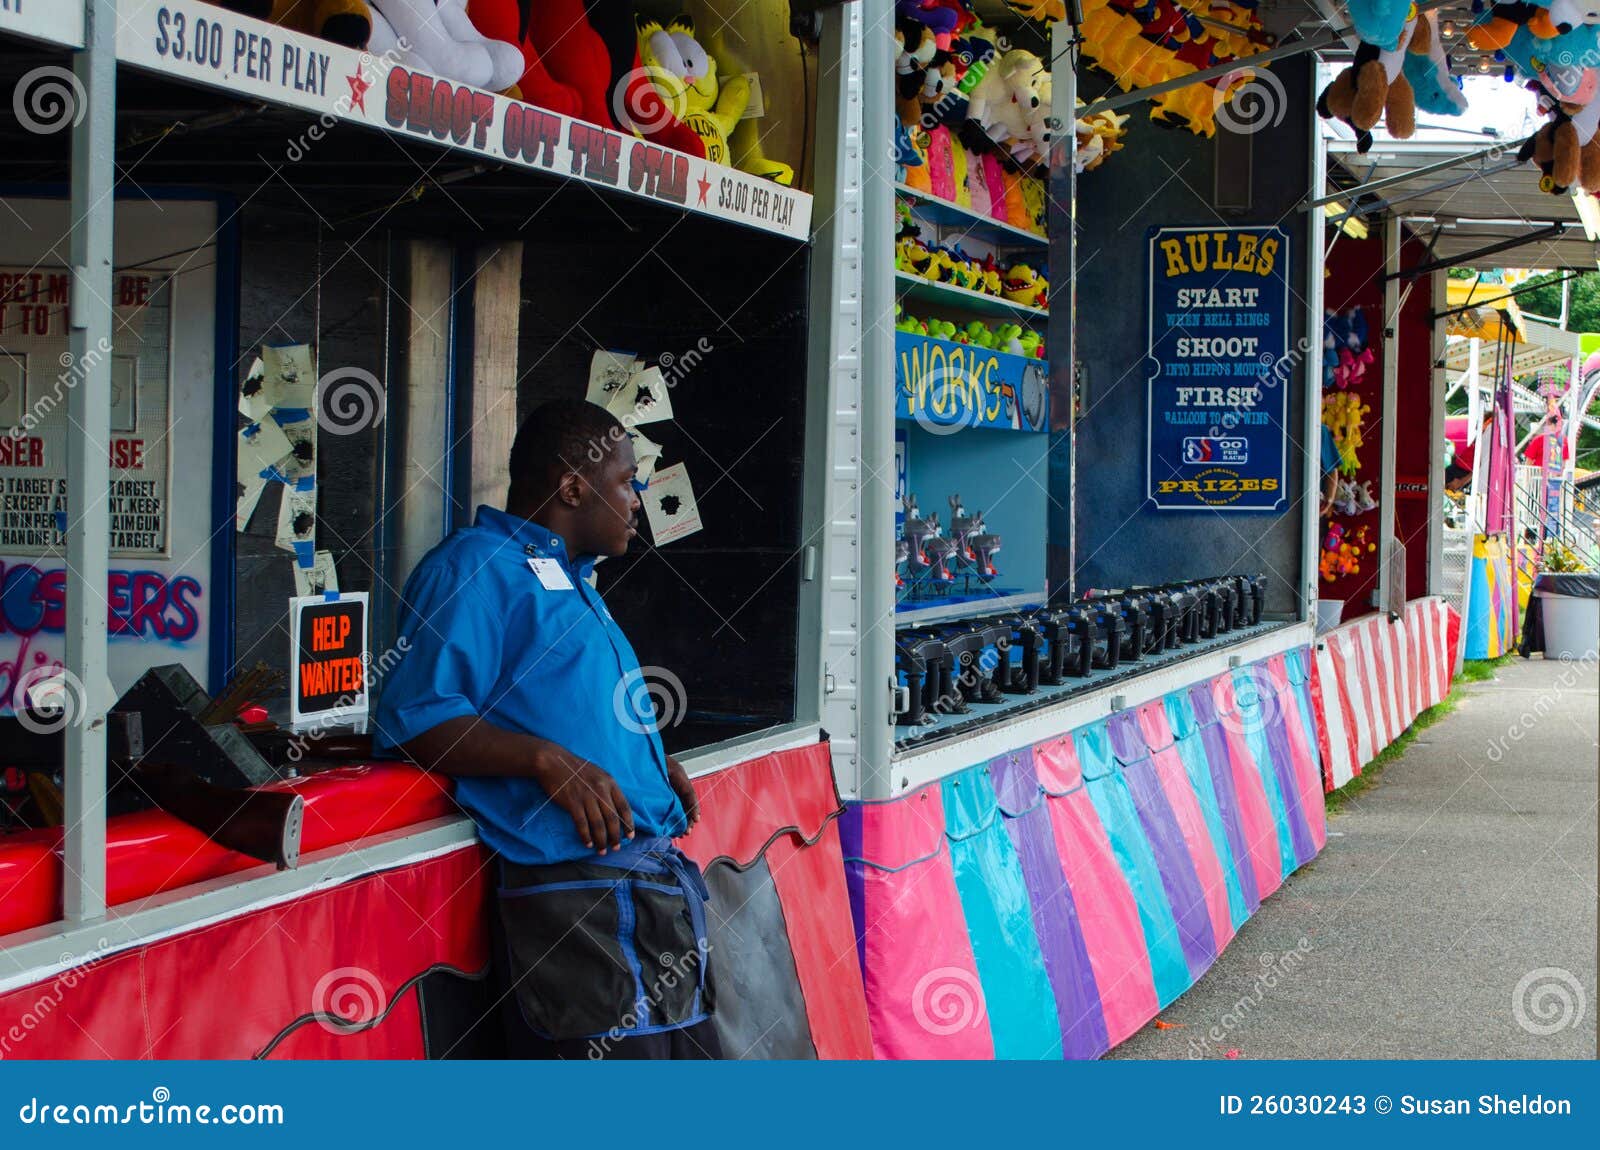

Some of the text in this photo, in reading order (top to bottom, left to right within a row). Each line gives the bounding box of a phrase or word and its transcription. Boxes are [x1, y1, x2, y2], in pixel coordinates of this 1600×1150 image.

[156, 7, 330, 96] $3.00 PER PLAY
[385, 66, 689, 204] SHOOT OUT THE STAR
[719, 177, 795, 226] $3.00 PER PLAY
[1160, 233, 1279, 277] RULES
[119, 275, 151, 306] BE
[1177, 288, 1259, 308] START
[20, 305, 49, 335] TO
[1166, 313, 1270, 326] WHEN BELL RINGS
[1176, 337, 1258, 357] SHOOT
[902, 342, 1001, 422] WORKS
[1165, 363, 1269, 376] INTO HIPPO'S MOUTH
[1176, 387, 1258, 406] FIRST
[1209, 411, 1220, 424] TO
[1243, 411, 1269, 424] WINS
[9, 479, 54, 494] TARGET
[109, 480, 155, 496] TARGET
[1158, 478, 1278, 492] PRIZES
[5, 496, 50, 511] EXCEPT
[312, 615, 351, 651] HELP
[300, 657, 363, 697] WANTED
